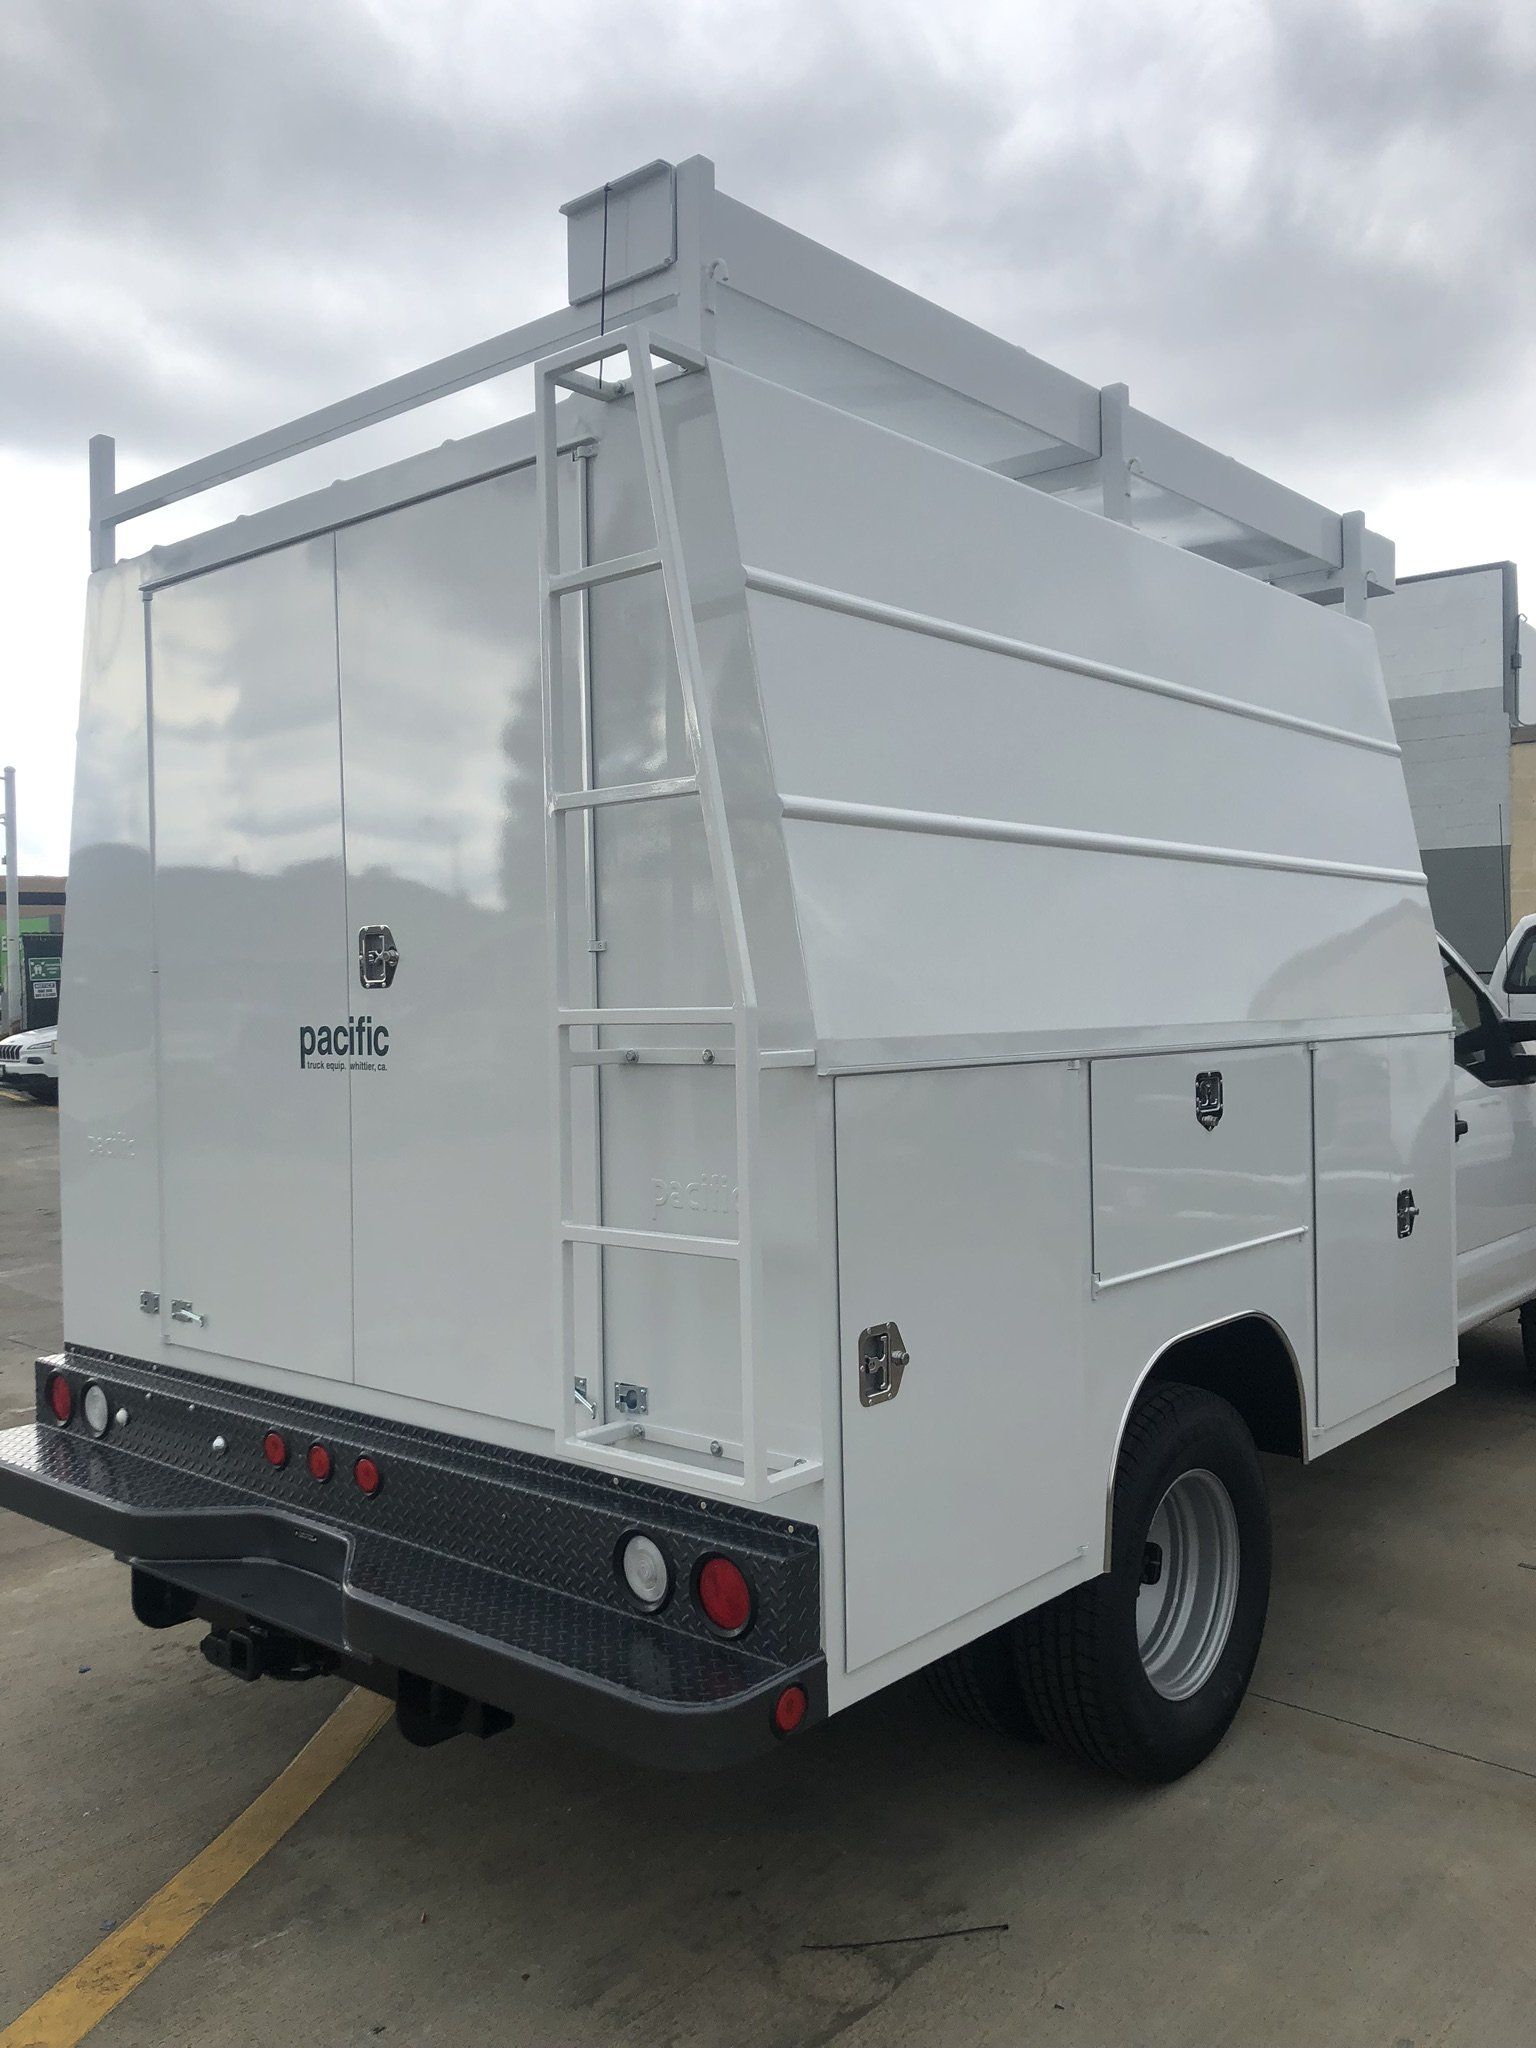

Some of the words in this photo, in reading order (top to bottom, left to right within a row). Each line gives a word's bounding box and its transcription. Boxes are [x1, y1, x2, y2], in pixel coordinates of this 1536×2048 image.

[300, 1016, 389, 1069] pacific
[307, 1061, 325, 1069] truck
[326, 1061, 347, 1071] equip.
[350, 1061, 376, 1071] whittier,
